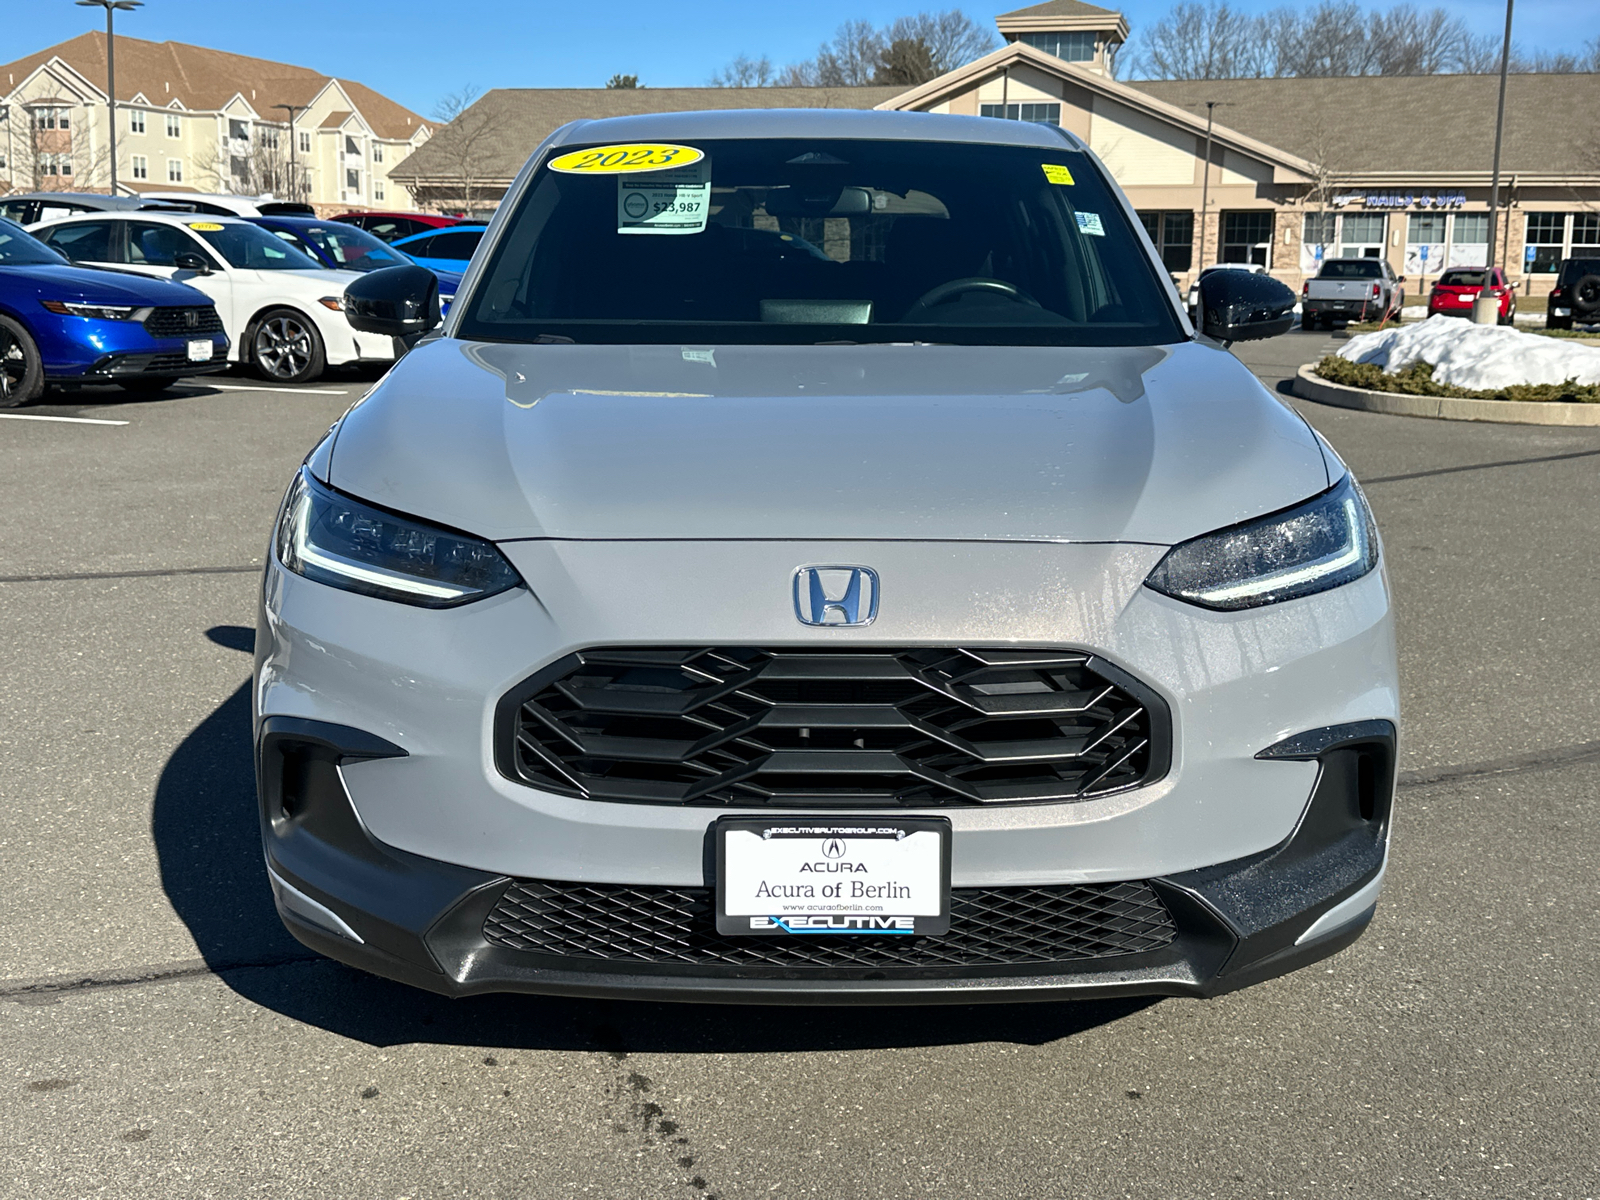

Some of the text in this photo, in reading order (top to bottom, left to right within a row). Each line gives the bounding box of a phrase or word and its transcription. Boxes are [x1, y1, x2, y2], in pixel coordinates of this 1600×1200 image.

[572, 149, 680, 169] 2023
[1366, 190, 1467, 206] NAILS & SPA
[653, 202, 701, 214] $23,987
[770, 827, 897, 835] EXECUTIVEAUTOGROUP.COM
[799, 862, 868, 873] ACURA
[755, 880, 912, 899] Acura of Berlin
[782, 904, 884, 912] www.acuraofberlin.com
[750, 916, 915, 930] EXECUTIVE
